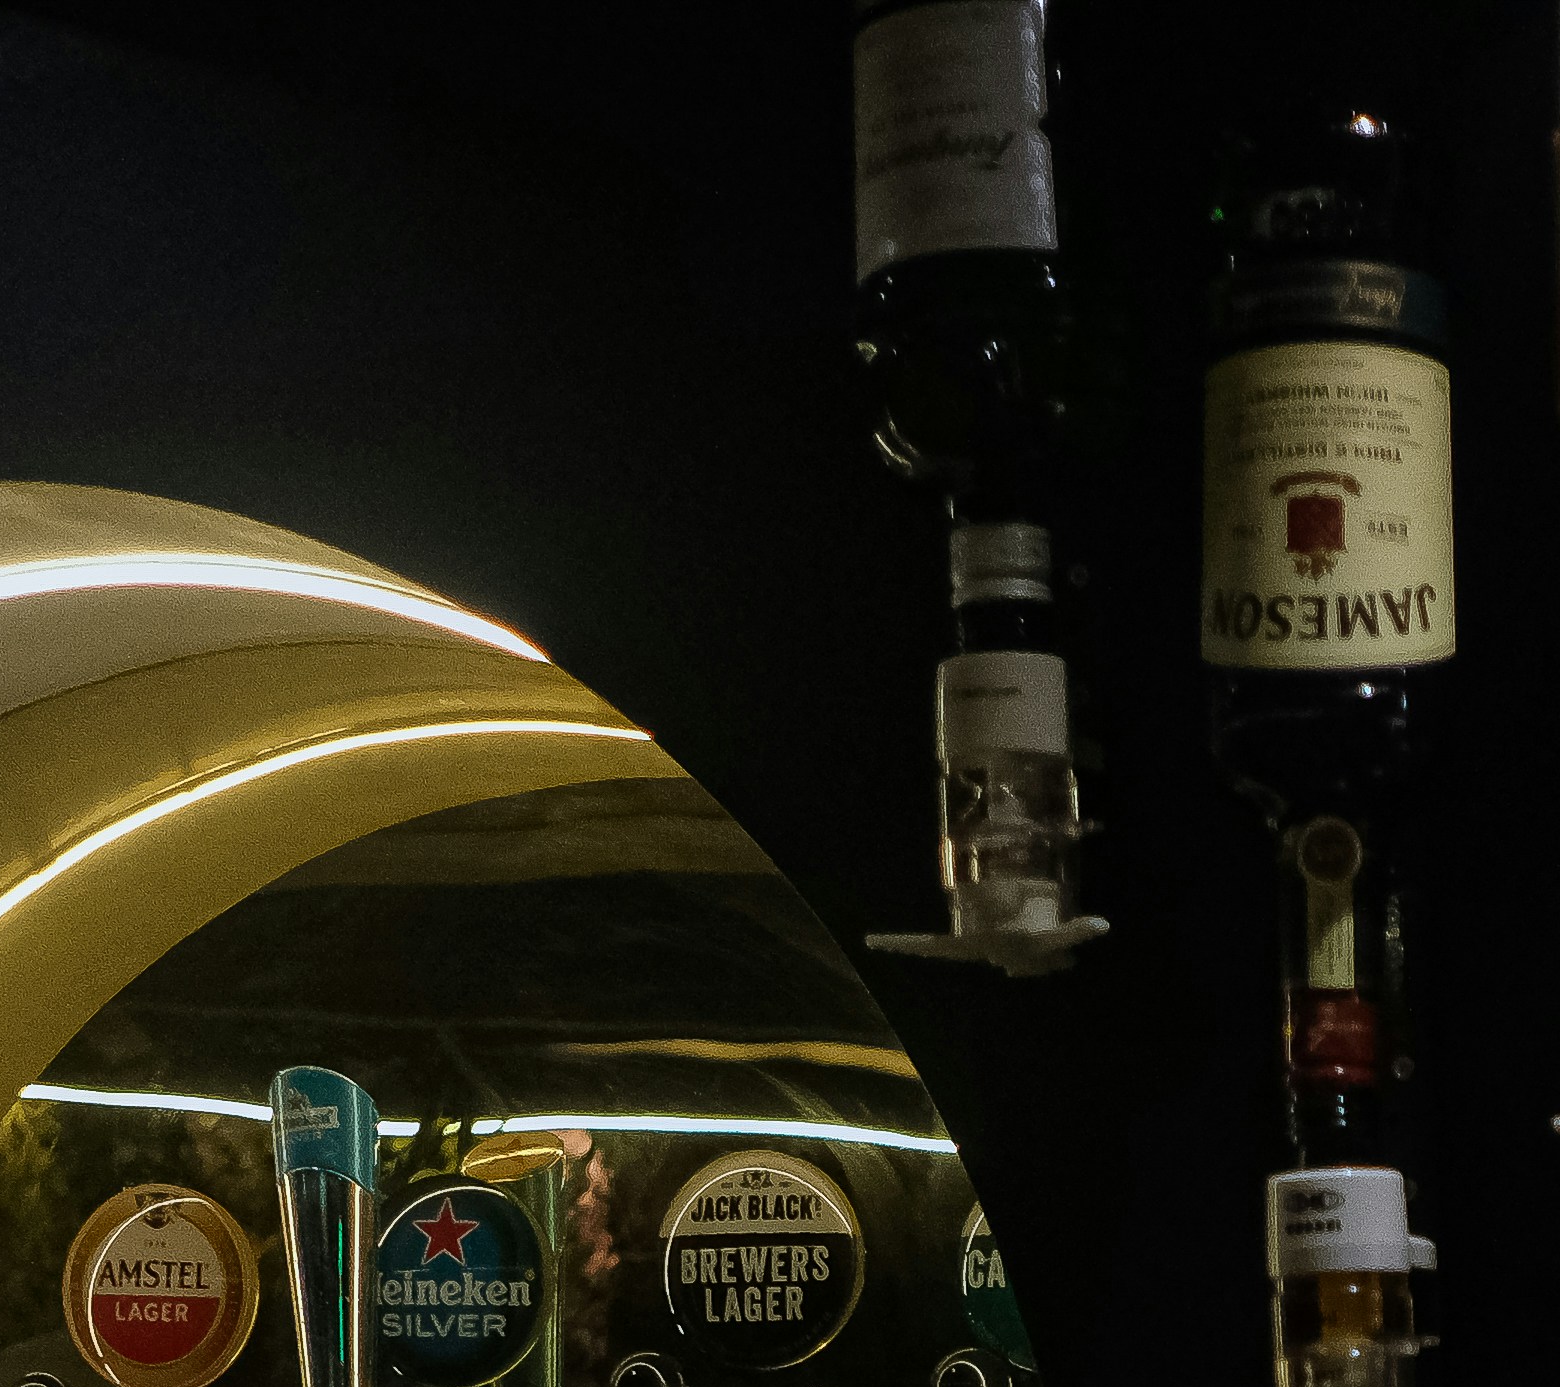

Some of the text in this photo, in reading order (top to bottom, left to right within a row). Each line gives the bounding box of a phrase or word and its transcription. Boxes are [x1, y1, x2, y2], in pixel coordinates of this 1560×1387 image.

[1211, 583, 1438, 643] JAMESON
[690, 1195, 742, 1222] JACK
[97, 1259, 210, 1290] AMSTEL
[679, 1245, 830, 1285] BREWERS
[114, 1301, 189, 1322] LAGER
[704, 1286, 804, 1323] LAGER
[382, 1313, 508, 1338] SILVER
